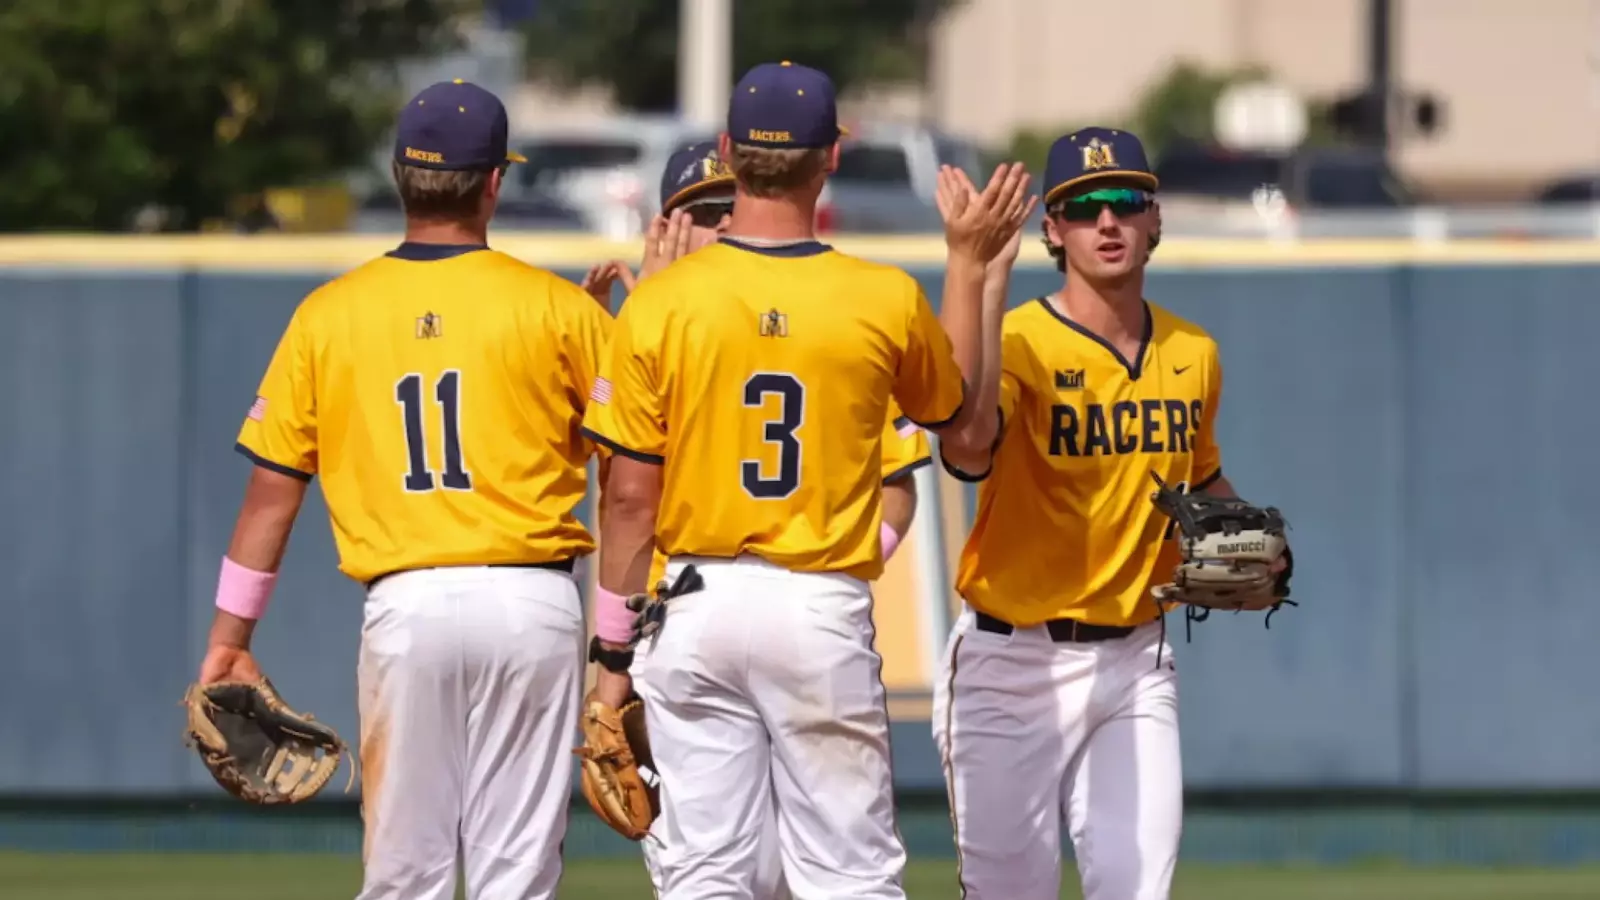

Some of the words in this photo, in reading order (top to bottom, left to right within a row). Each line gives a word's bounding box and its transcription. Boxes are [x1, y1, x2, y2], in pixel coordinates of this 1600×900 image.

[394, 369, 474, 493] 11
[740, 371, 806, 500] 3
[1217, 539, 1266, 555] marucci
